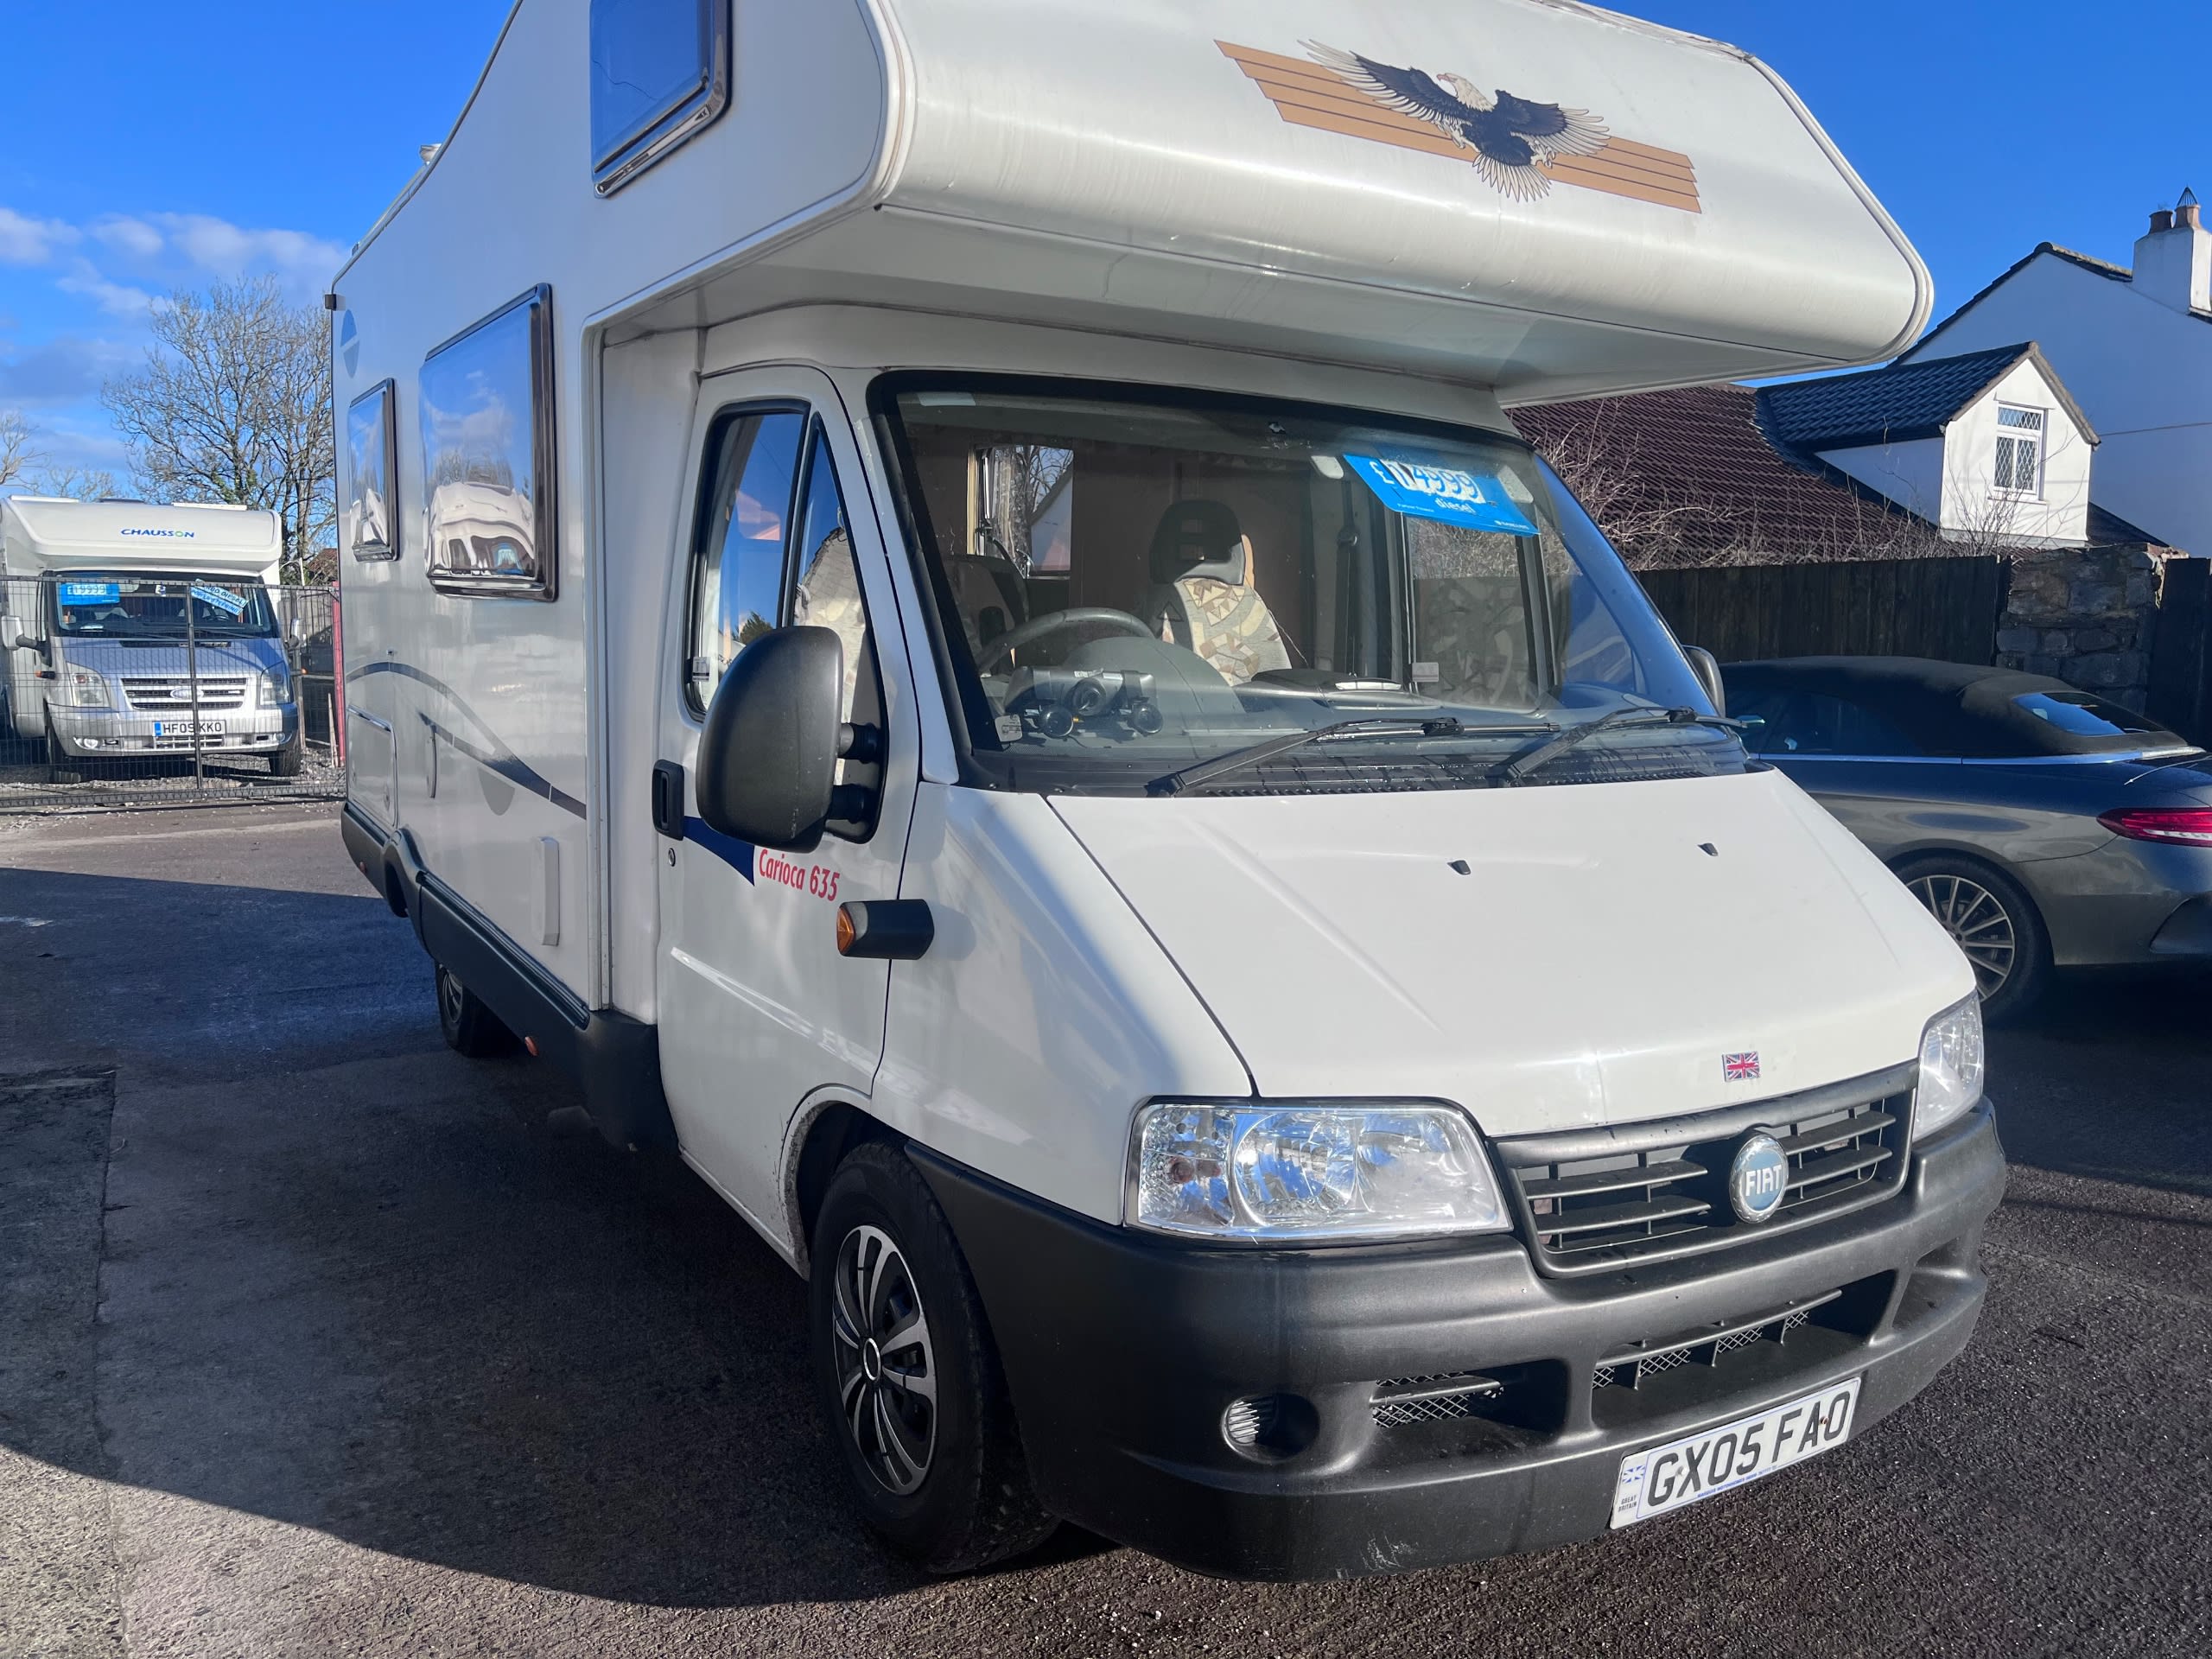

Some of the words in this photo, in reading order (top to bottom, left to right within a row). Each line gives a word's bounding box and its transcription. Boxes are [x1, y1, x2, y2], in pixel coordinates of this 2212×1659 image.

[1434, 498, 1477, 516] diesel
[121, 529, 194, 537] CHAUSSON
[199, 722, 222, 733] KKO
[759, 849, 805, 890] Carioca
[810, 865, 840, 901] 635
[1745, 1164, 1782, 1197] FIAT
[1647, 1421, 1764, 1507] GX05
[1771, 1390, 1851, 1464] FAO
[1621, 1495, 1637, 1505] GREAT
